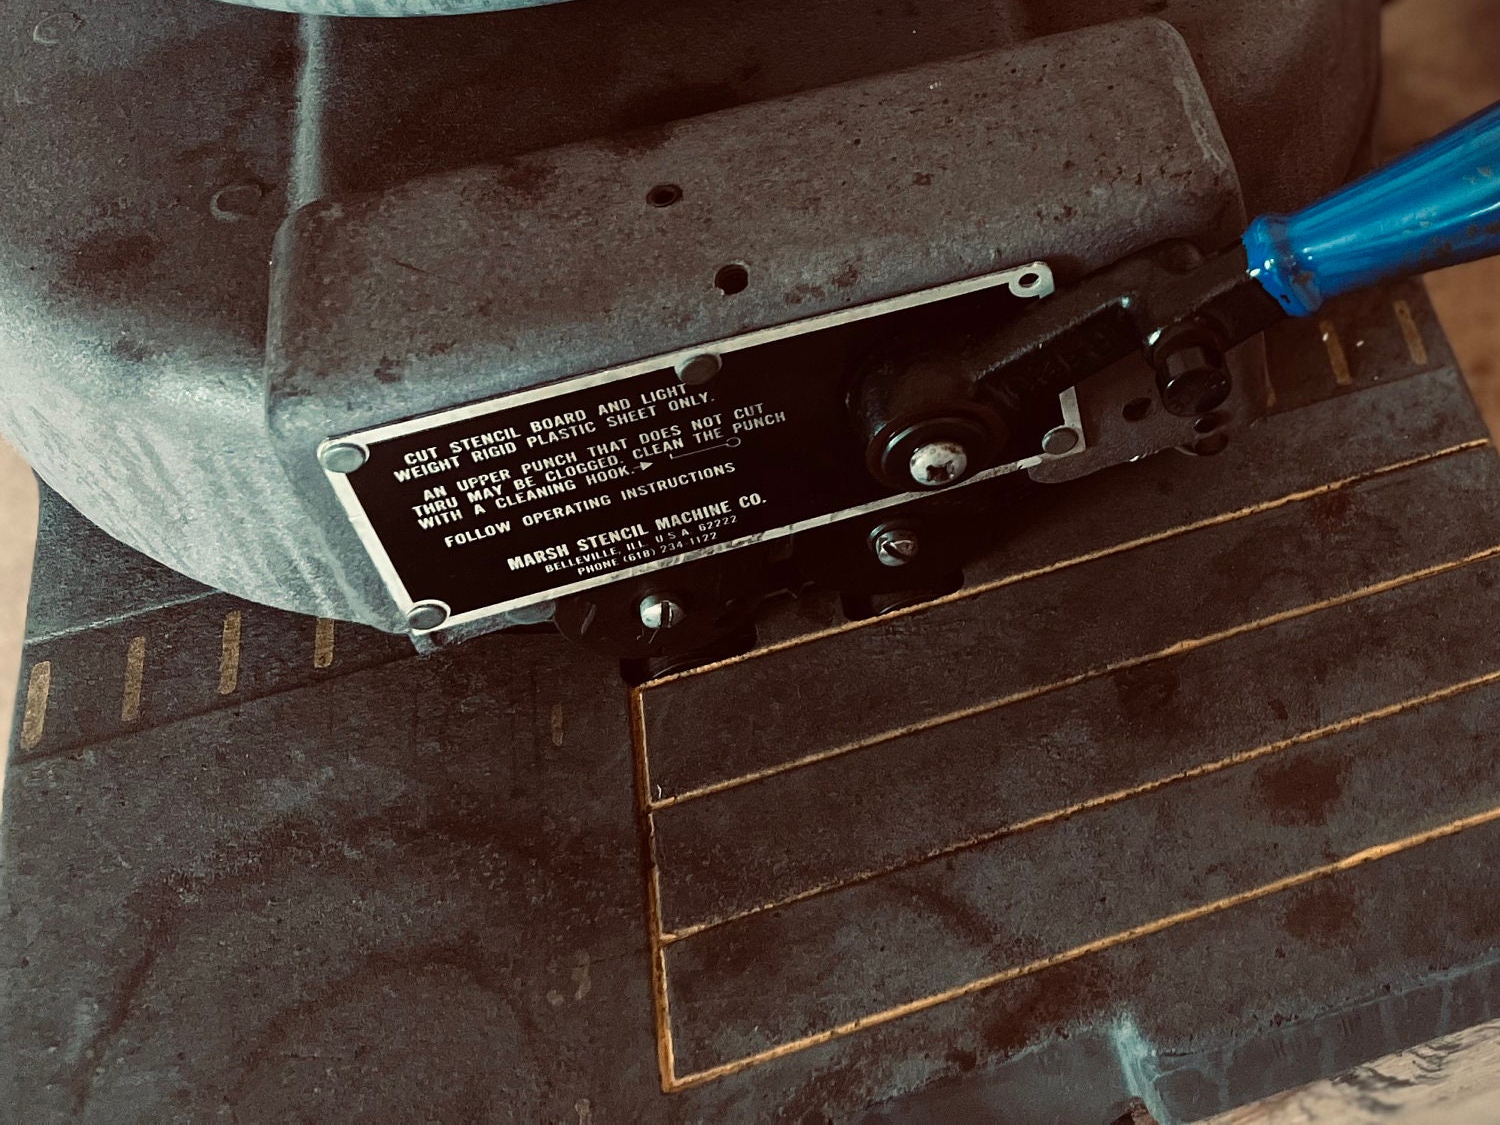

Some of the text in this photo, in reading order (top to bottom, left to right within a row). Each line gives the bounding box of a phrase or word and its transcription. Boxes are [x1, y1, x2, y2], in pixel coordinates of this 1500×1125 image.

[393, 391, 716, 483] WEIGHT RIGID PLASTIC SHEET ONLY.
[403, 383, 686, 466] CUT STENCIL BOARD AND LIGHT
[412, 411, 786, 517] THRU MAY BE CLOGGED. CLEAN THE PUNCH
[423, 403, 764, 501] AN UPPER PUNCH THAT DOES NOT CUT
[418, 465, 636, 531] WITH A CLEANING HOOK.
[444, 462, 736, 548] FOLLOW OPERATING INSTRUCTIONS
[506, 493, 767, 571] MARSH STENCIL MACHINE CO.
[544, 546, 622, 573] BELLEVILLE,
[698, 515, 738, 533] 62222
[577, 557, 620, 576] PHONE
[623, 549, 656, 563] (618)
